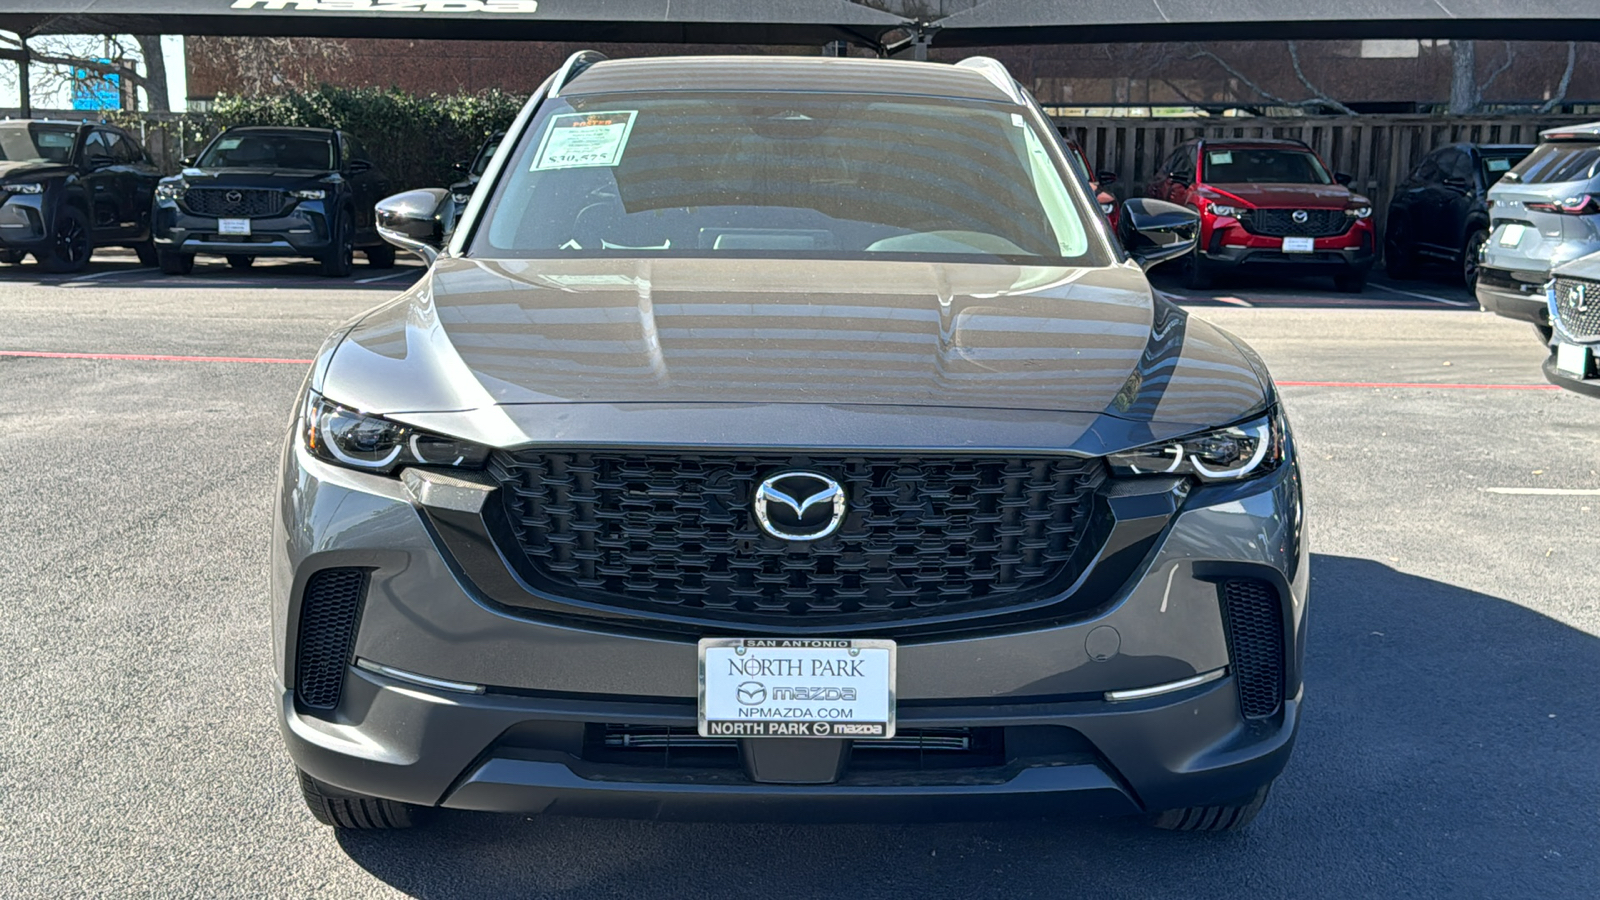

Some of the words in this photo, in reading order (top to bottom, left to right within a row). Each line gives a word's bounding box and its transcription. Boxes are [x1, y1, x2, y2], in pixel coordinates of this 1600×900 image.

[782, 640, 848, 648] ANTONIO
[728, 657, 803, 677] NORTH
[811, 659, 865, 677] PARK
[772, 686, 857, 701] mazda
[738, 707, 853, 719] NPMAZDA.COM
[711, 722, 764, 735] NORTH
[769, 722, 809, 735] PARK
[833, 724, 882, 735] mazda
